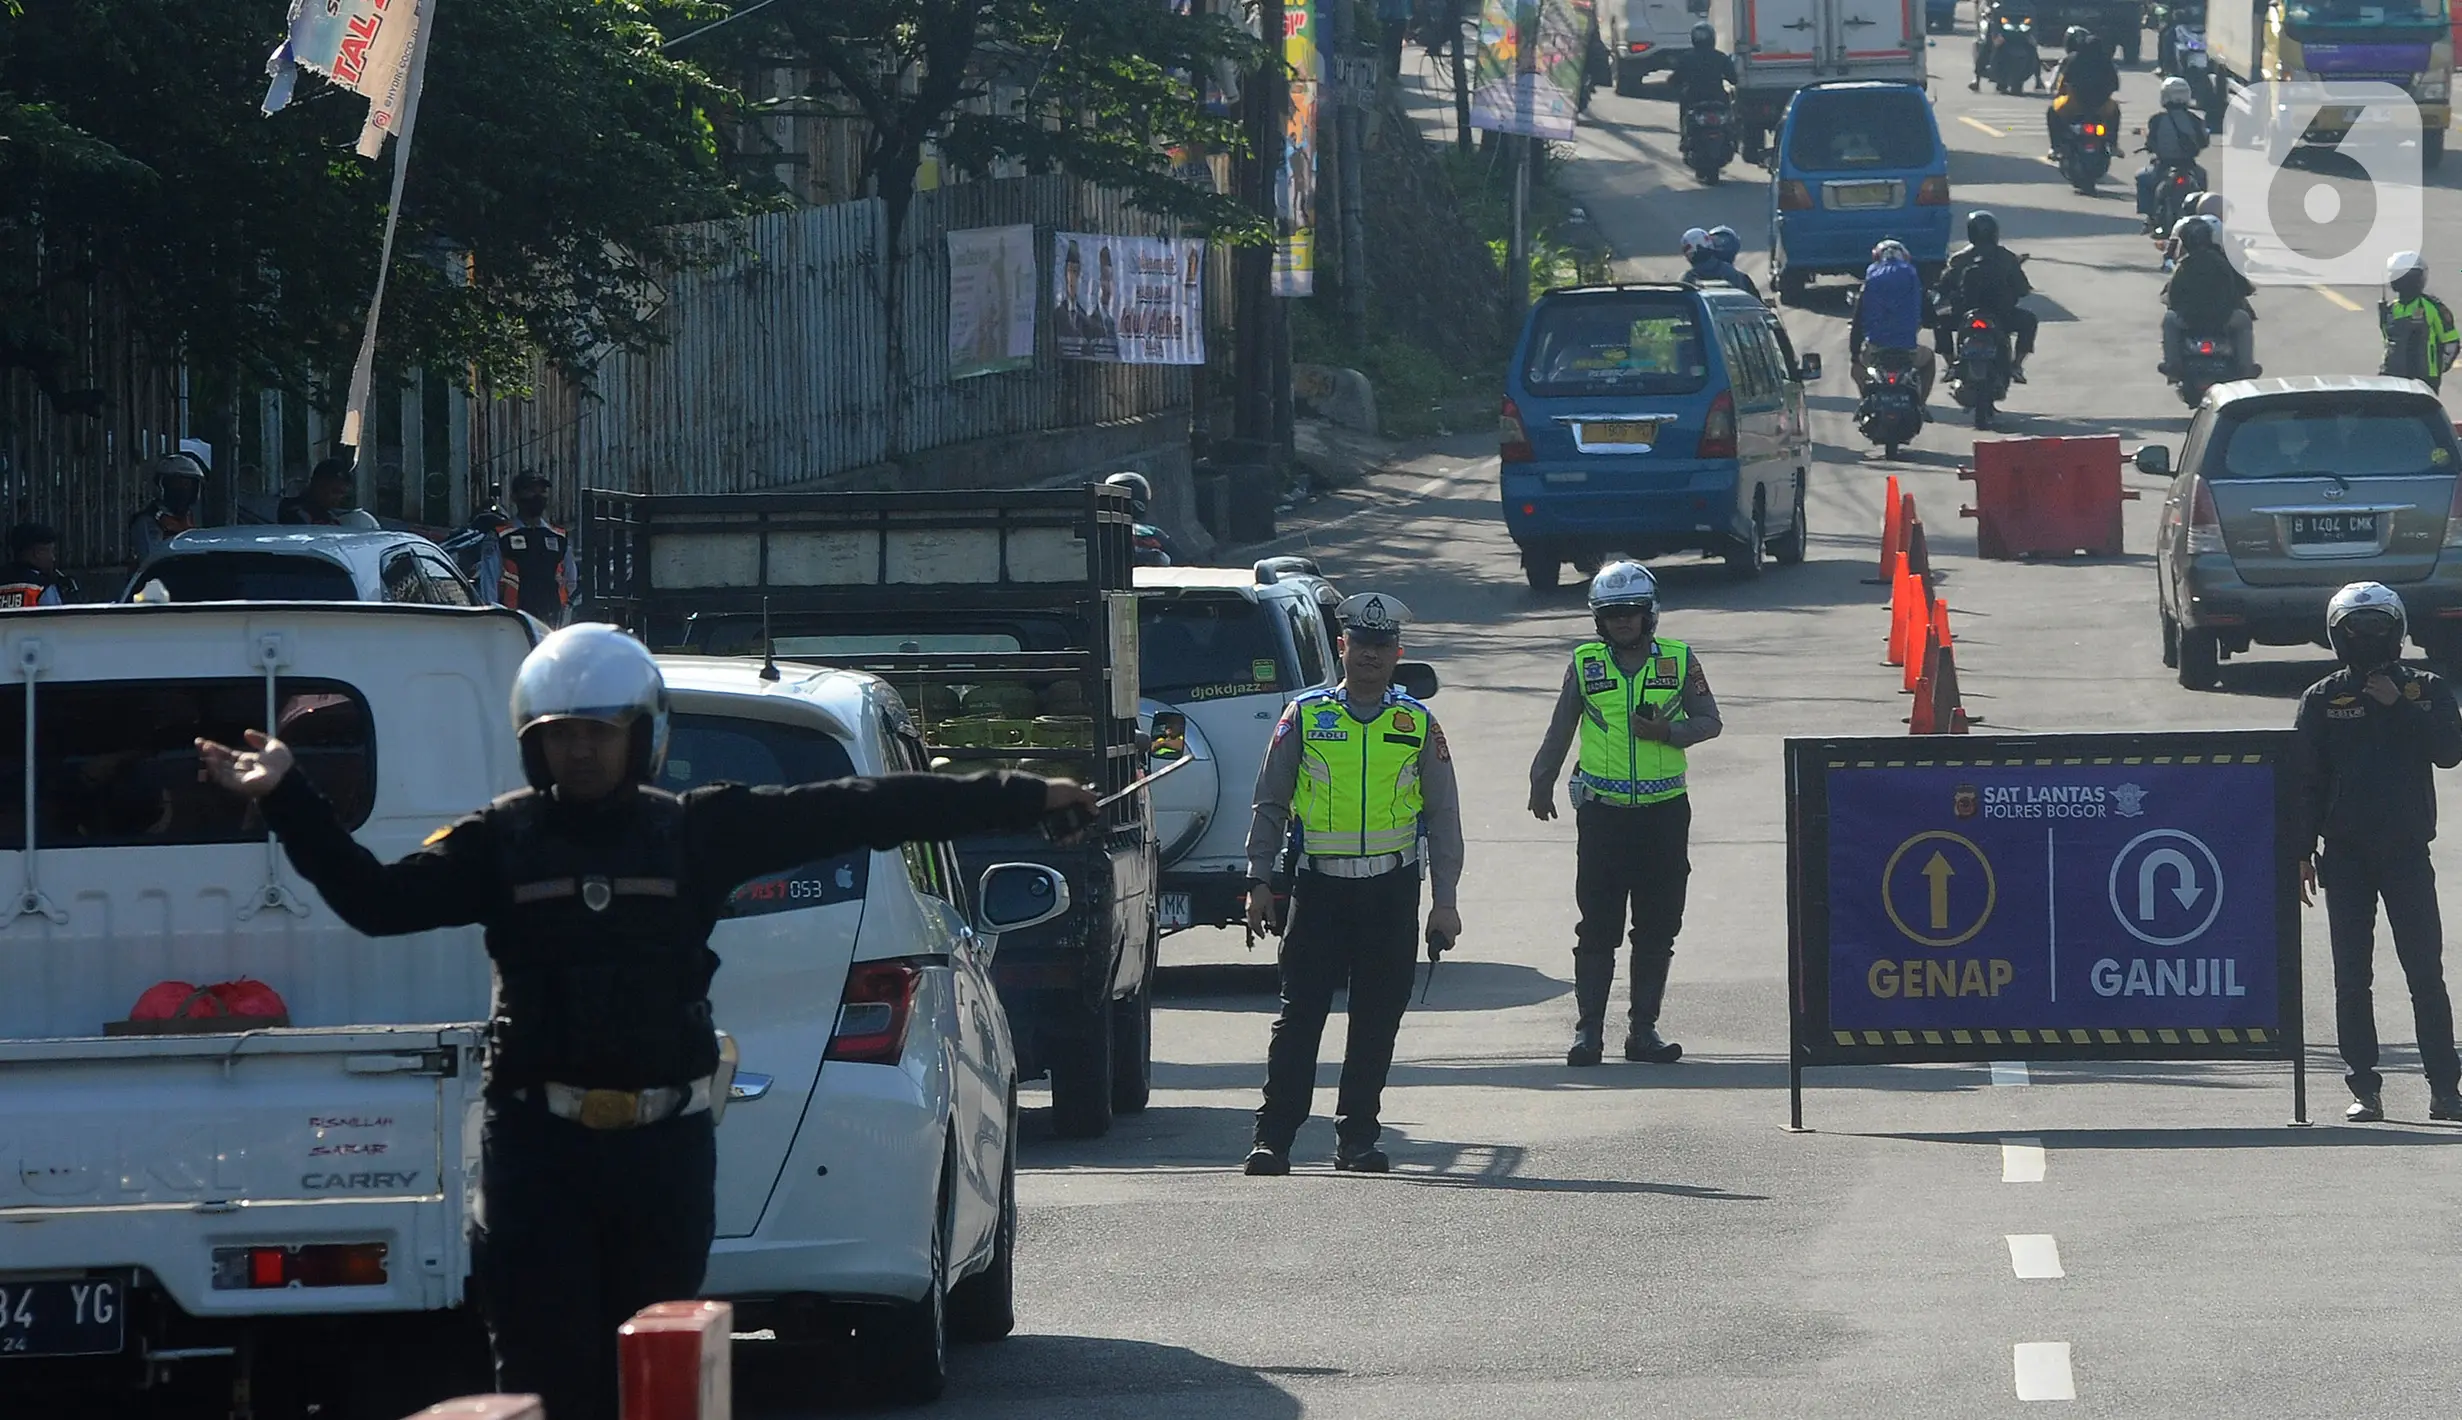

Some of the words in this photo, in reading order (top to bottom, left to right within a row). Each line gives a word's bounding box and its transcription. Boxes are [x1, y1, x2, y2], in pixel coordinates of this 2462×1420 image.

[2312, 518, 2340, 532] 1404
[2350, 517, 2374, 531] CMK
[1191, 683, 1262, 699] djokdjazz
[1310, 730, 1344, 739] FADLI
[1984, 786, 2020, 803] SAT
[2027, 786, 2106, 803] LANTAS
[1985, 804, 2042, 818] POLRES
[2049, 804, 2107, 818] BOGOR
[790, 880, 822, 898] 053
[1868, 958, 2013, 999] GENAP
[2091, 957, 2245, 997] GANJIL
[301, 1171, 420, 1190] CARRY
[71, 1283, 113, 1325] YG
